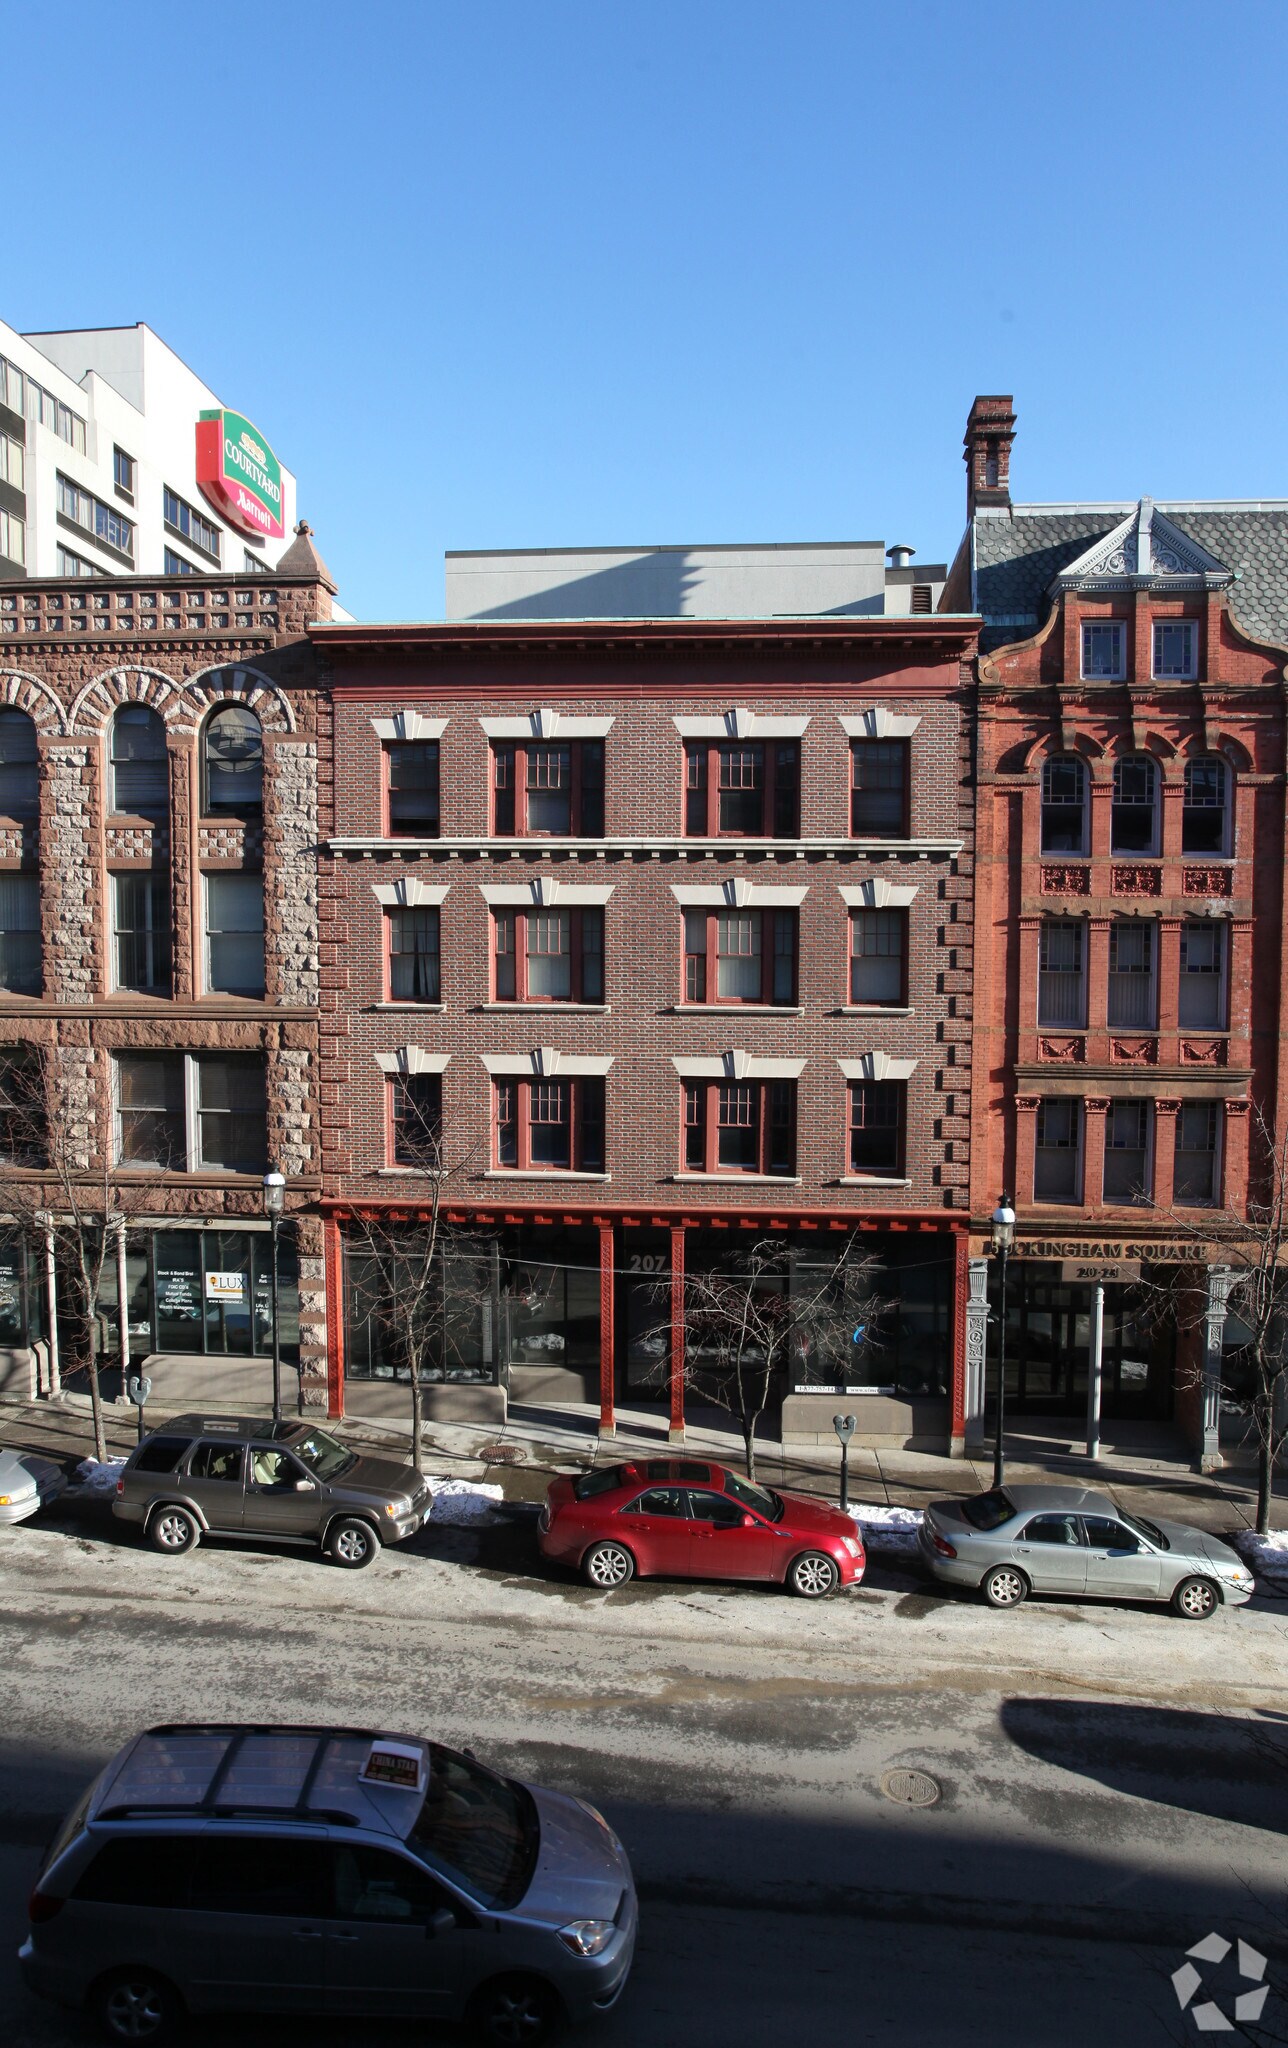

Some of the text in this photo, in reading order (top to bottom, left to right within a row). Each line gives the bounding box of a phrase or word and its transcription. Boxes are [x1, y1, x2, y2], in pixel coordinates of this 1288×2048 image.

[225, 438, 280, 503] COURTYARD
[236, 488, 271, 530] Marriott
[1132, 1243, 1208, 1261] SQUARE
[630, 1254, 667, 1272] 207
[219, 1277, 246, 1289] LUX
[397, 1759, 417, 1772] STAR
